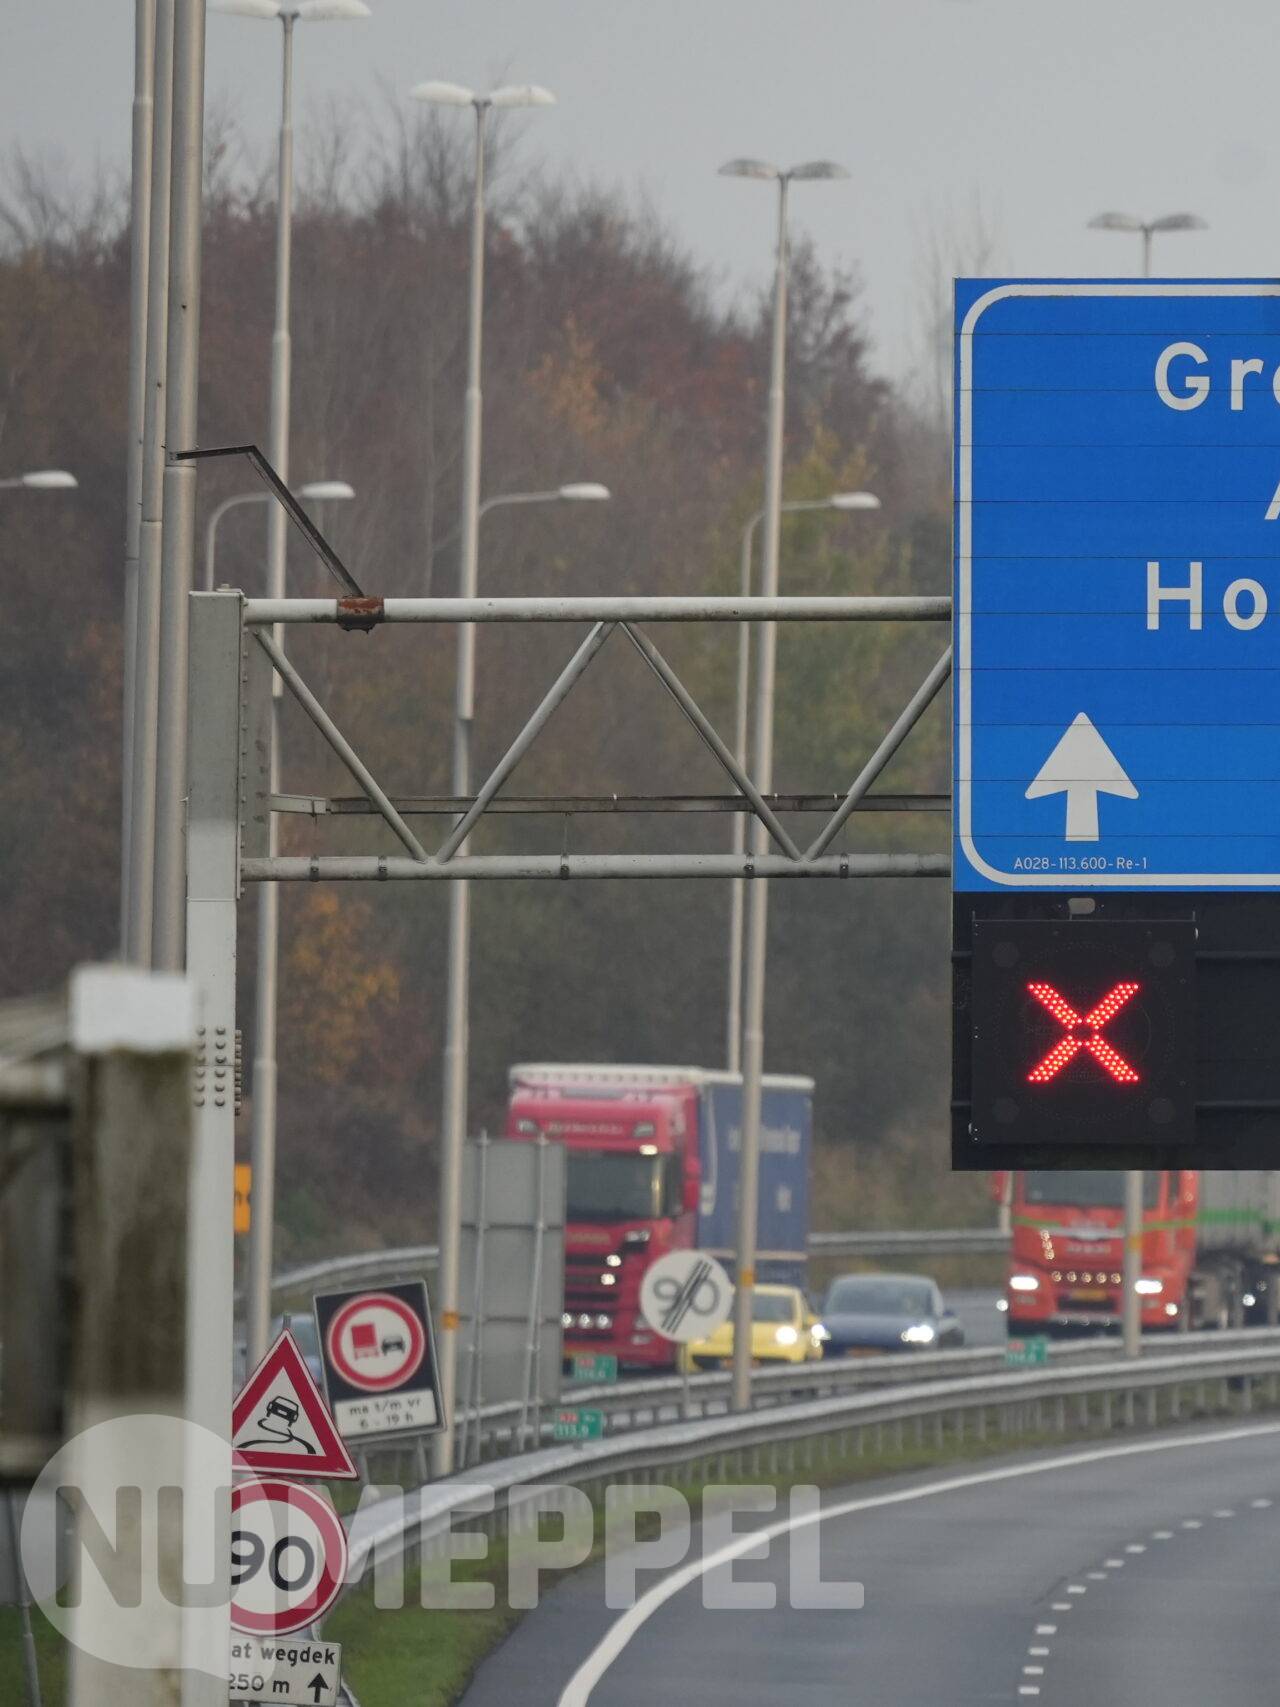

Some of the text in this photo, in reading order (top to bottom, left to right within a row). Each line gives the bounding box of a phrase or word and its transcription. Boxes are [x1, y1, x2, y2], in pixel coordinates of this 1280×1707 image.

[231, 1530, 315, 1592] 90
[231, 1642, 336, 1668] at wegdek
[272, 1678, 291, 1694] m
